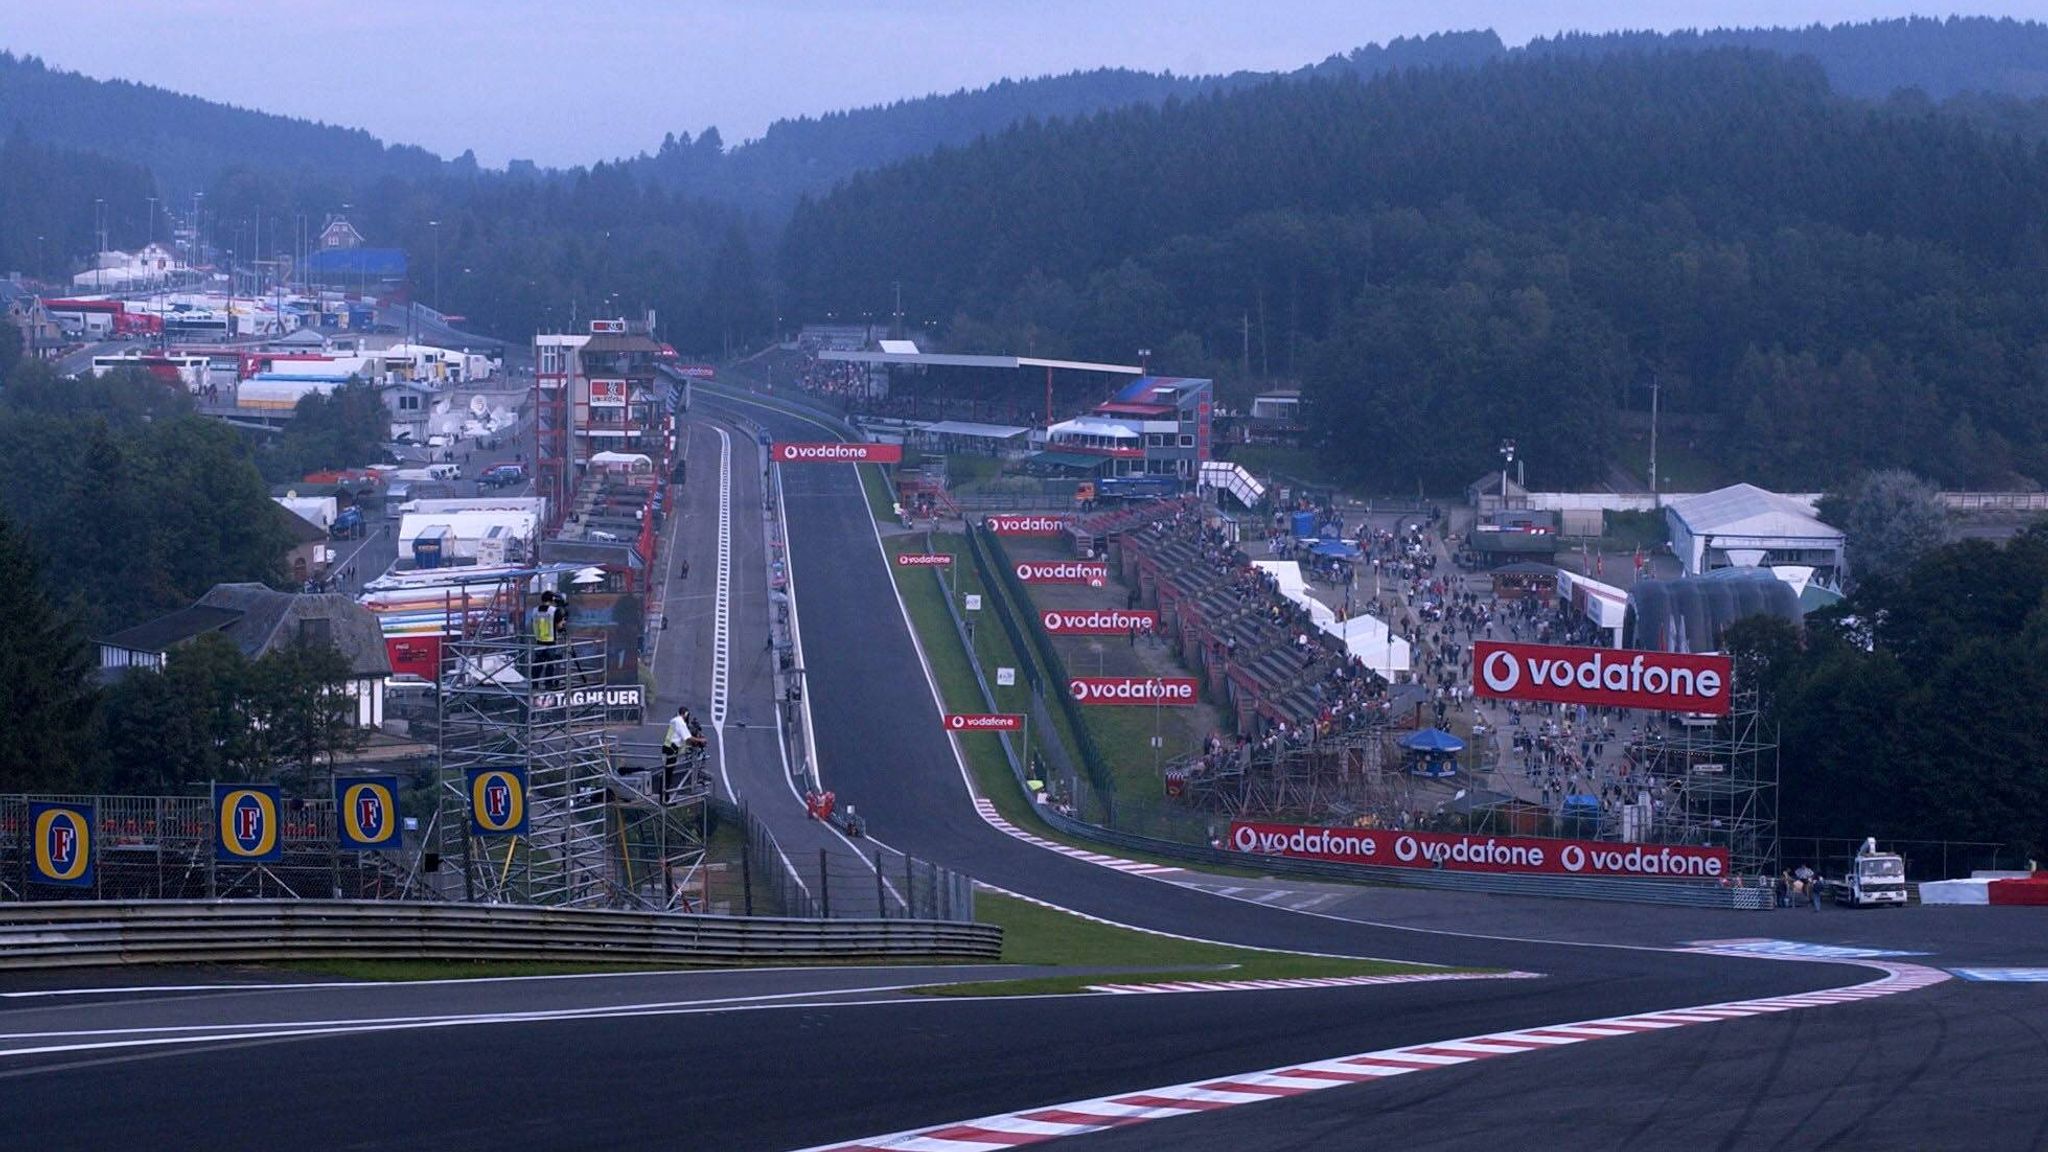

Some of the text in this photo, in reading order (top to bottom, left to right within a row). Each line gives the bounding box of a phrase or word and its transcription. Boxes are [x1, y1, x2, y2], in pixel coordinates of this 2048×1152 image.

[799, 445, 867, 458] vodafone
[1063, 612, 1153, 629] vodafone
[1527, 652, 1722, 698] vodafone
[1091, 679, 1193, 698] vodafone
[966, 716, 1014, 726] vodafone
[1258, 828, 1722, 876] vodafone vodafone vodafone
